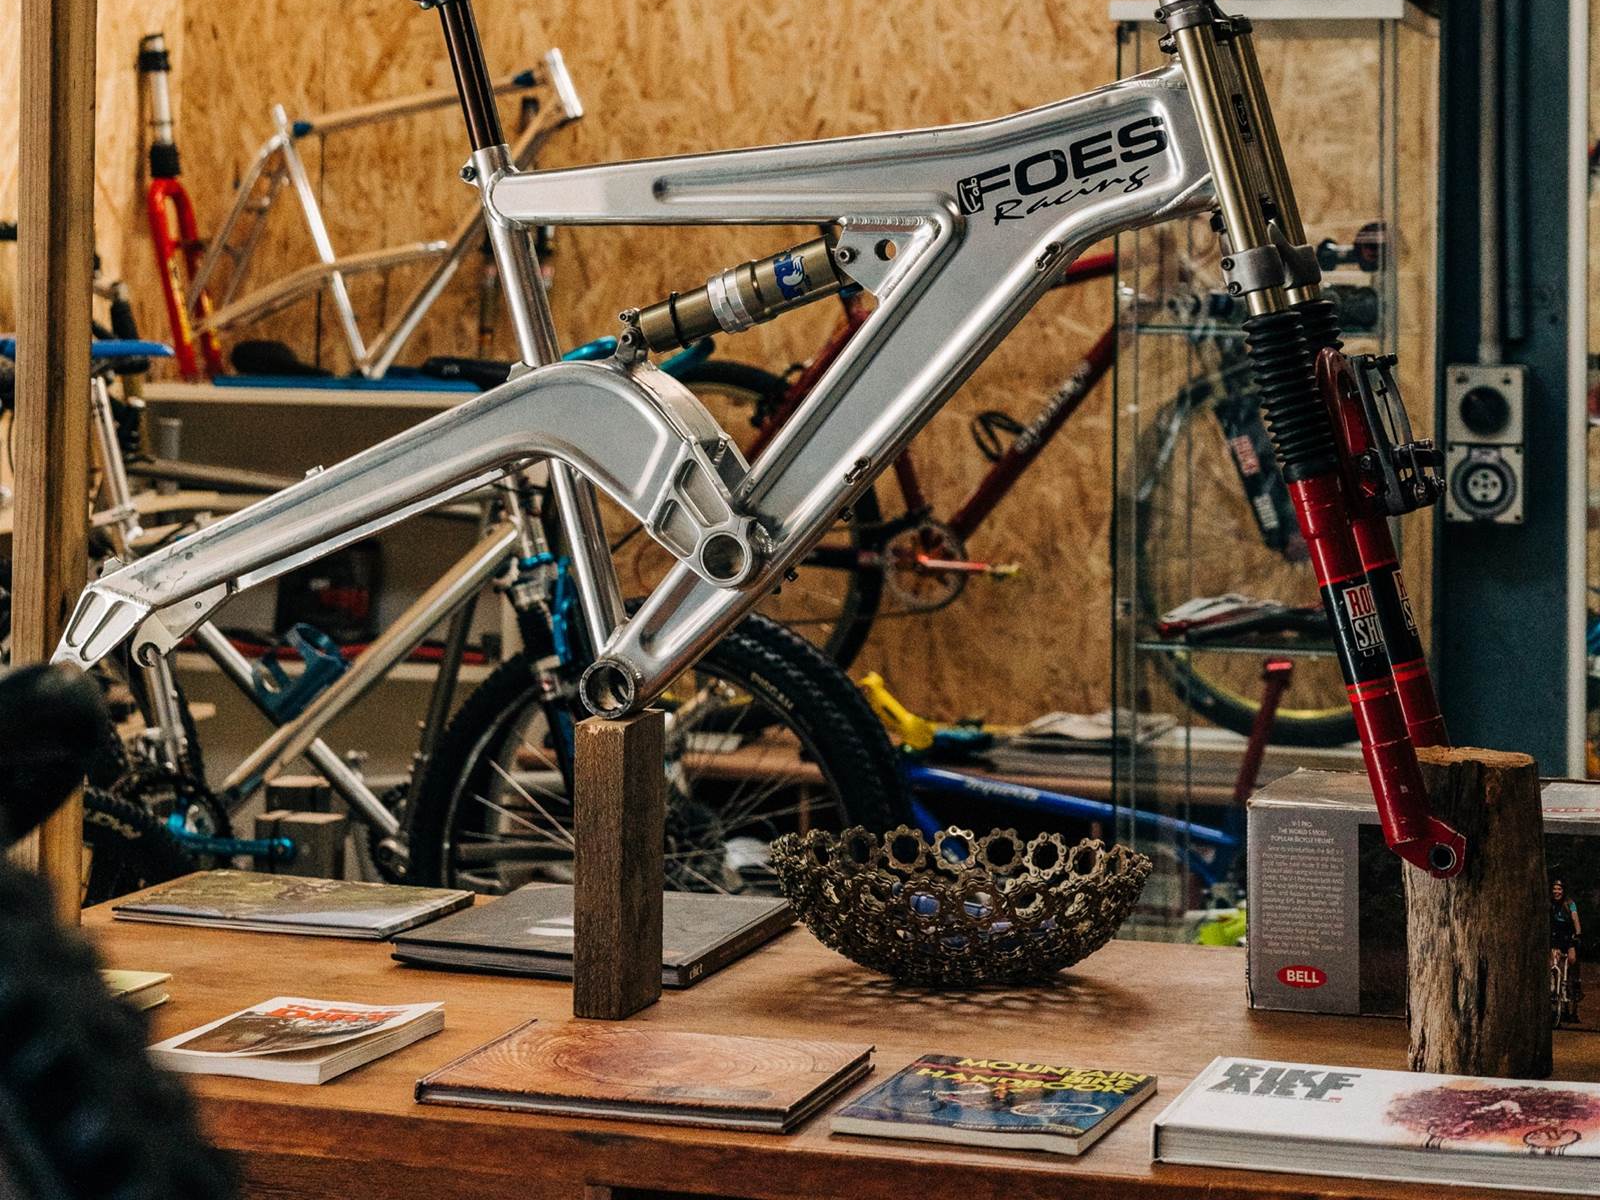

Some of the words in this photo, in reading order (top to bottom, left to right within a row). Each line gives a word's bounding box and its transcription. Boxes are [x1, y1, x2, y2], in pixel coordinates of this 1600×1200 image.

[957, 114, 1169, 215] FOES
[993, 166, 1150, 226] Racing
[1345, 585, 1377, 617] RO
[1354, 613, 1383, 648] SH
[1286, 969, 1320, 984] BELL
[915, 1068, 1136, 1094] HANDBOOK
[956, 1058, 1148, 1083] MOUNTAIN
[1061, 1074, 1140, 1087] BIKE
[1222, 1062, 1362, 1090] BIKE
